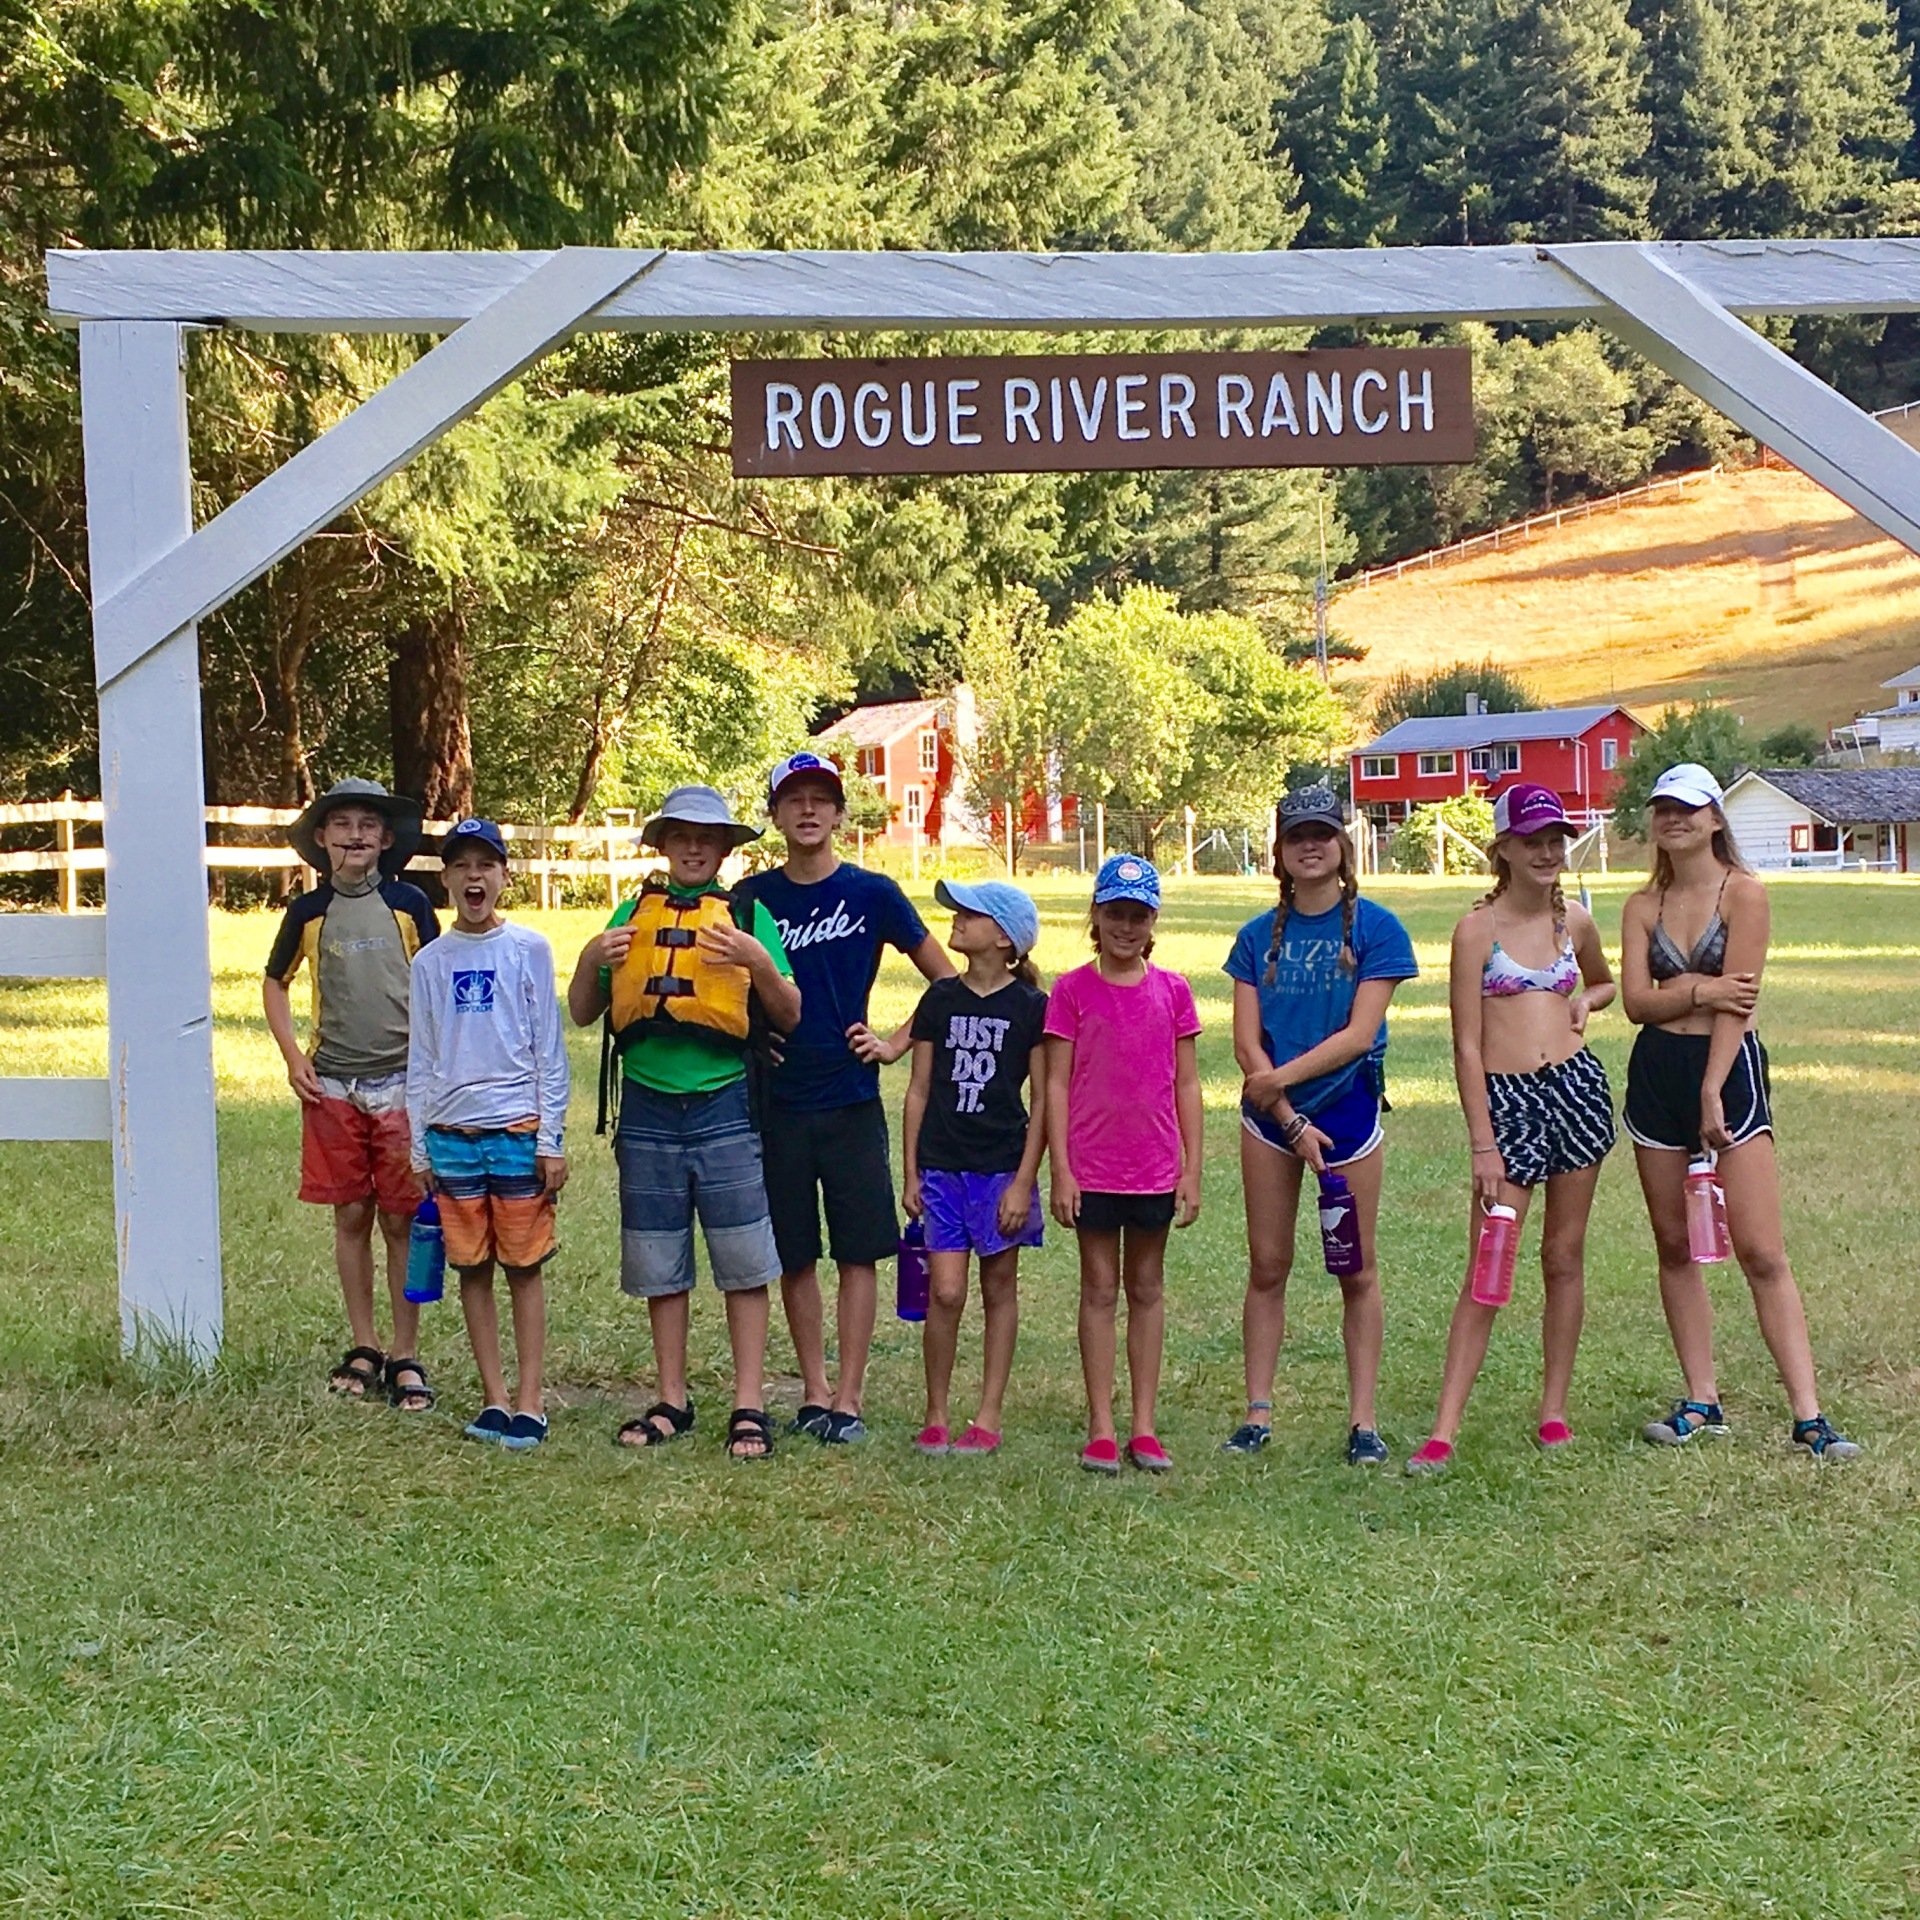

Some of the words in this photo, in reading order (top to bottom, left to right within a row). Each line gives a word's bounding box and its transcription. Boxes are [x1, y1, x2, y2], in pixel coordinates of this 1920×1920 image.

[766, 380, 982, 450] ROGUE
[1004, 372, 1197, 443] RIVER
[1218, 368, 1434, 438] RANCH
[1264, 939, 1345, 964] OUZE
[945, 1015, 1011, 1052] JUST
[951, 1048, 996, 1083] DO
[956, 1081, 985, 1113] IT.
